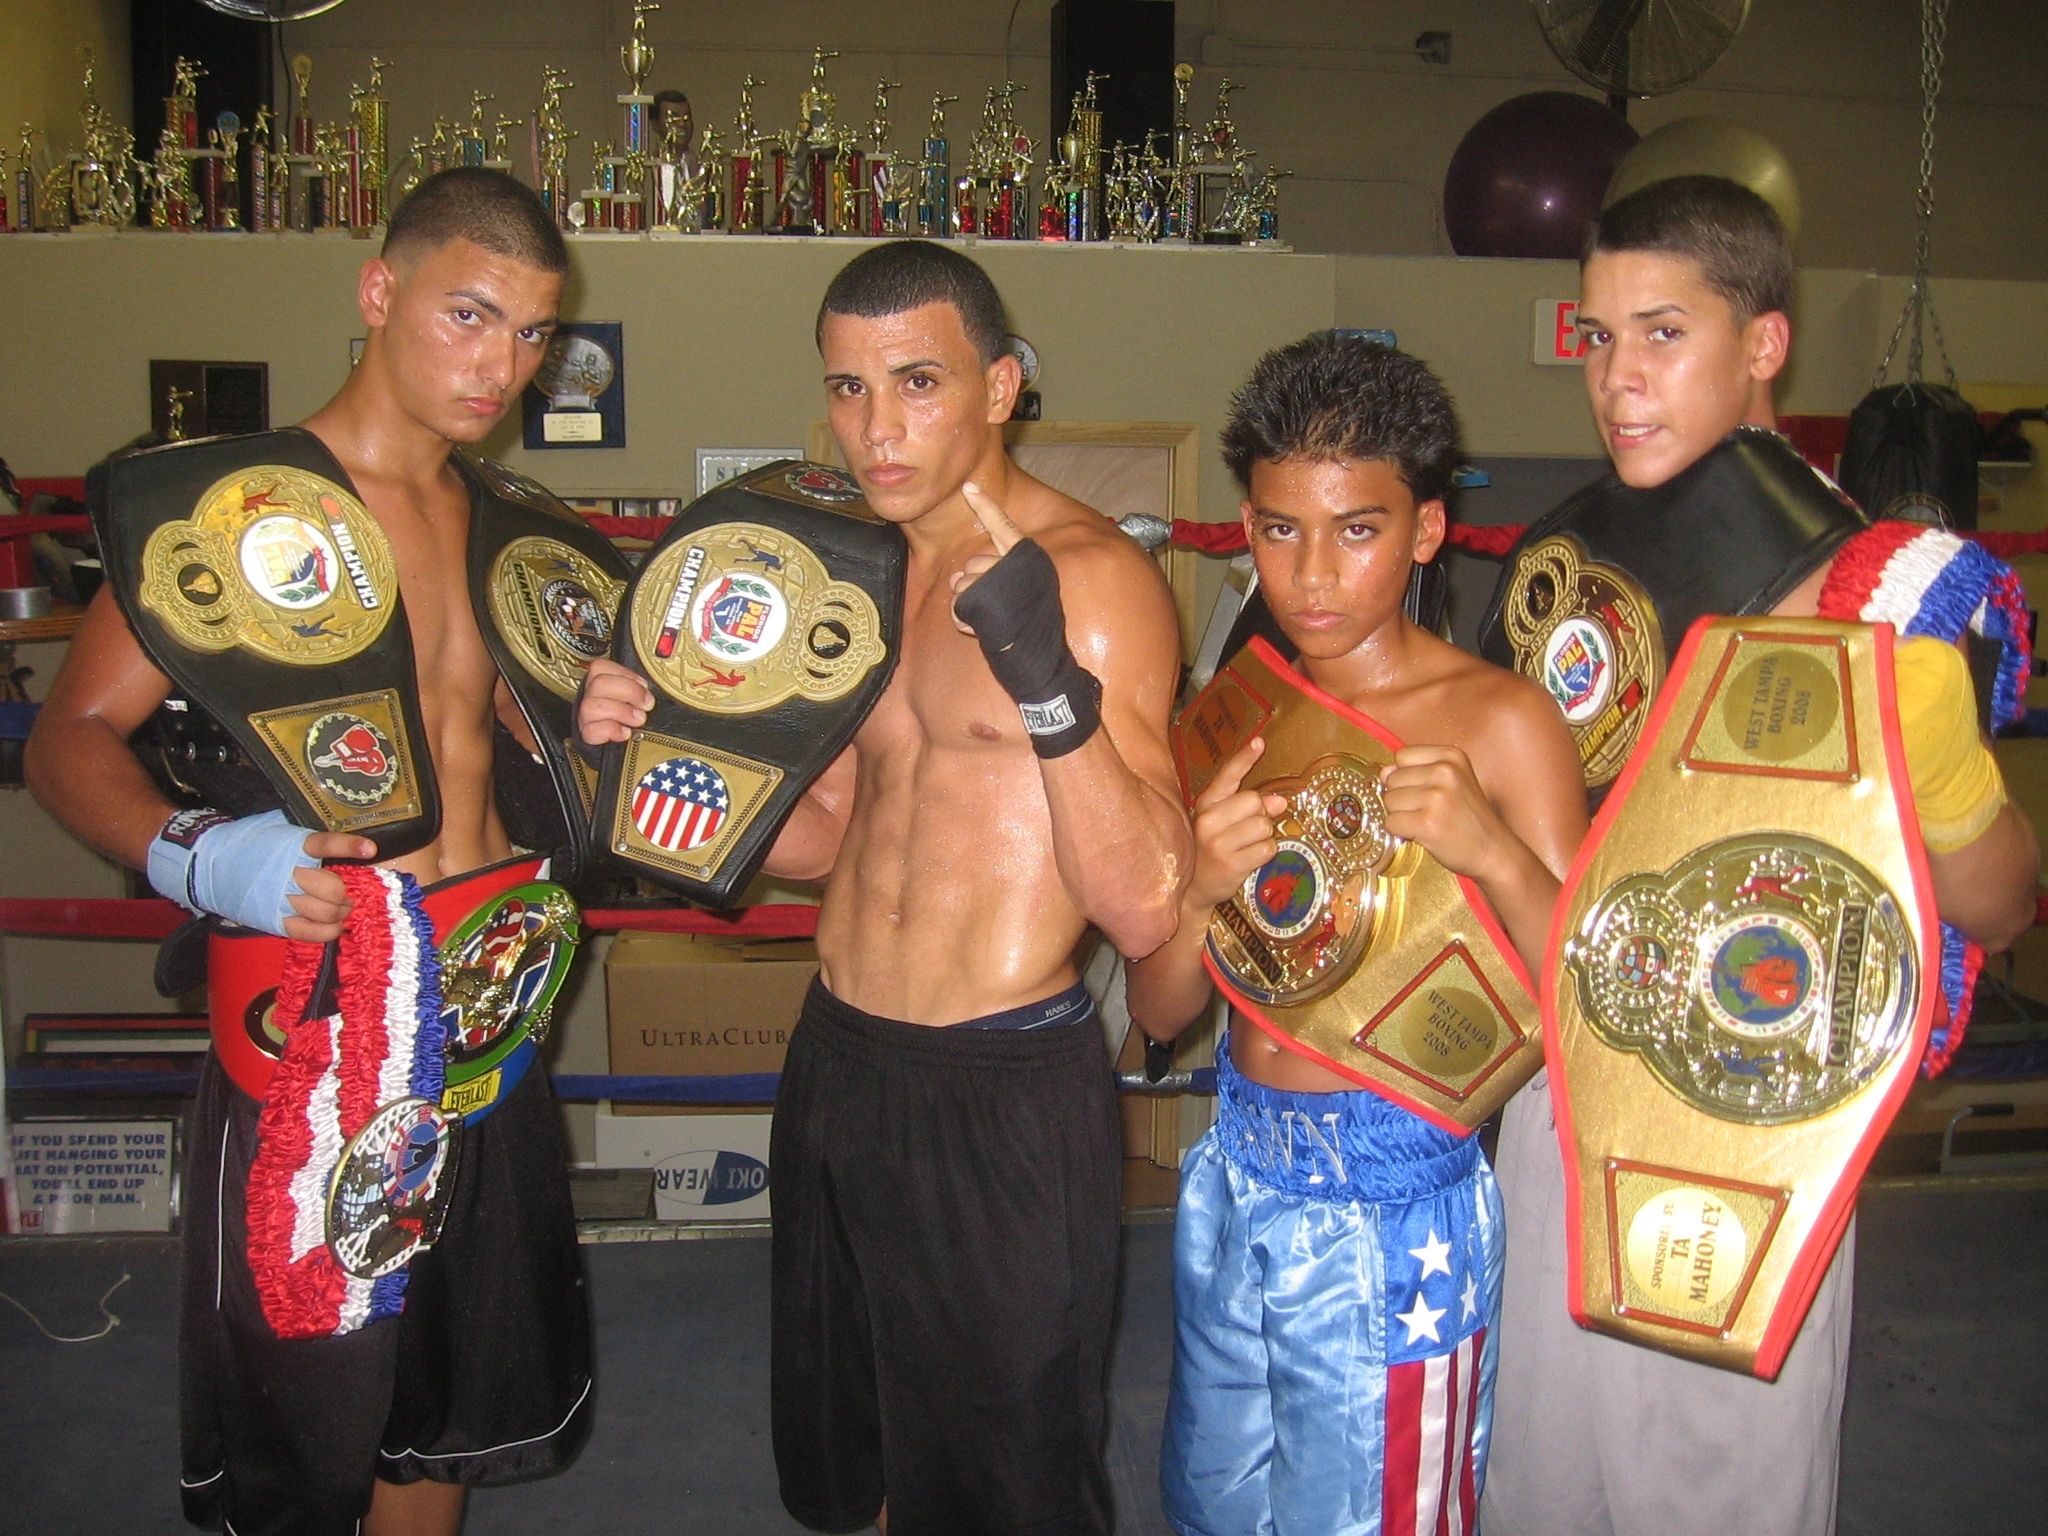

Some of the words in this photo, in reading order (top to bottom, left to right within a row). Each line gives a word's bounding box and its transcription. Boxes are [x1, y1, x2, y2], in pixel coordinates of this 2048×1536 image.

[329, 521, 379, 610] CHAMPION
[513, 563, 544, 638] CHAMPION
[664, 547, 705, 630] CHAMPION
[736, 601, 764, 637] PAL
[1557, 643, 1584, 676] PAL
[1753, 657, 1778, 705] TAMPA
[1766, 676, 1792, 734] BOXING
[1578, 703, 1623, 765] HAMPION
[1743, 708, 1765, 750] WEST
[1828, 906, 1864, 1063] CHAMPION
[640, 1028, 789, 1047] ULTRACLUB
[1428, 990, 1460, 1020] WEST
[1458, 1017, 1493, 1050] TAMPA
[1428, 1012, 1470, 1050] BOXING
[451, 1077, 492, 1108] EVERLAST
[11, 1135, 25, 1147] IF
[32, 1135, 63, 1147] YOU
[68, 1134, 118, 1146] SPEND
[123, 1134, 166, 1146] YOUR
[16, 1150, 41, 1160] IFE
[46, 1149, 119, 1161] HANGING
[124, 1149, 166, 1160] YOUR
[32, 1178, 82, 1190] YOU'L
[88, 1178, 118, 1190] END
[123, 1178, 145, 1189] UP
[46, 1165, 69, 1176] ON
[74, 1163, 164, 1176] POTENTIAL,
[726, 1167, 766, 1190] OKI
[33, 1194, 43, 1204] A
[48, 1194, 93, 1205] POR
[98, 1193, 141, 1204] MAN.
[1669, 1237, 1692, 1260] TA
[1688, 1201, 1722, 1305] MAHONEY
